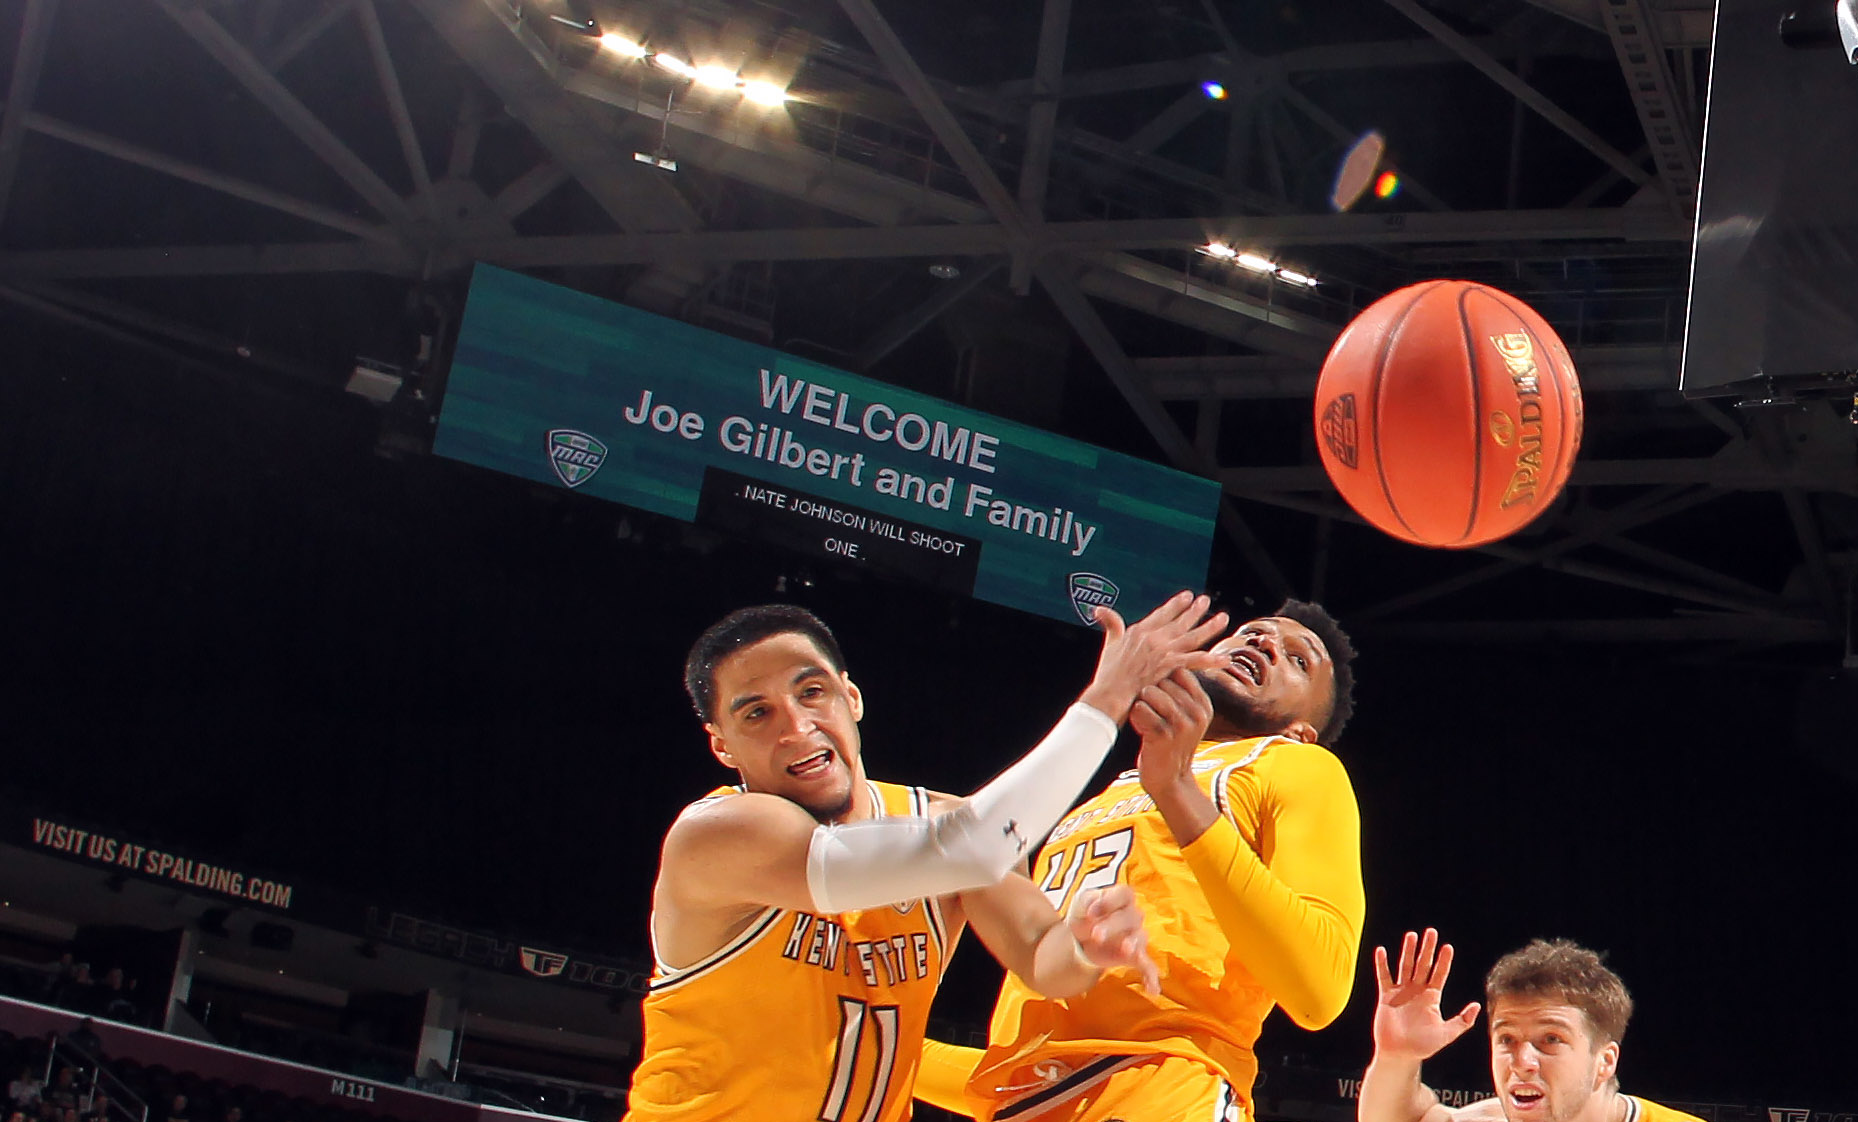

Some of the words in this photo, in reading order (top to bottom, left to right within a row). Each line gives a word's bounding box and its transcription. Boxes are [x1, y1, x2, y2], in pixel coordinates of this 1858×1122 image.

[758, 369, 1001, 473] WELCOME
[1490, 328, 1543, 511] SPALDING
[549, 446, 601, 471] MAC
[623, 390, 703, 442] Joe
[719, 415, 865, 488] Gilbert
[875, 464, 953, 513] and
[963, 482, 1097, 556] Family
[744, 484, 787, 513] NATE
[789, 495, 868, 533] JOHNSON
[868, 517, 907, 543] WILL
[908, 528, 965, 558] SHOOT
[825, 538, 860, 561] ONE
[1073, 588, 1114, 610] MAC
[33, 818, 88, 854] VISIT
[87, 835, 117, 863] US
[118, 843, 146, 869] AT
[145, 850, 292, 908] SPALDING.COM
[330, 1077, 376, 1102] M111
[1338, 1078, 1361, 1099] VIS
